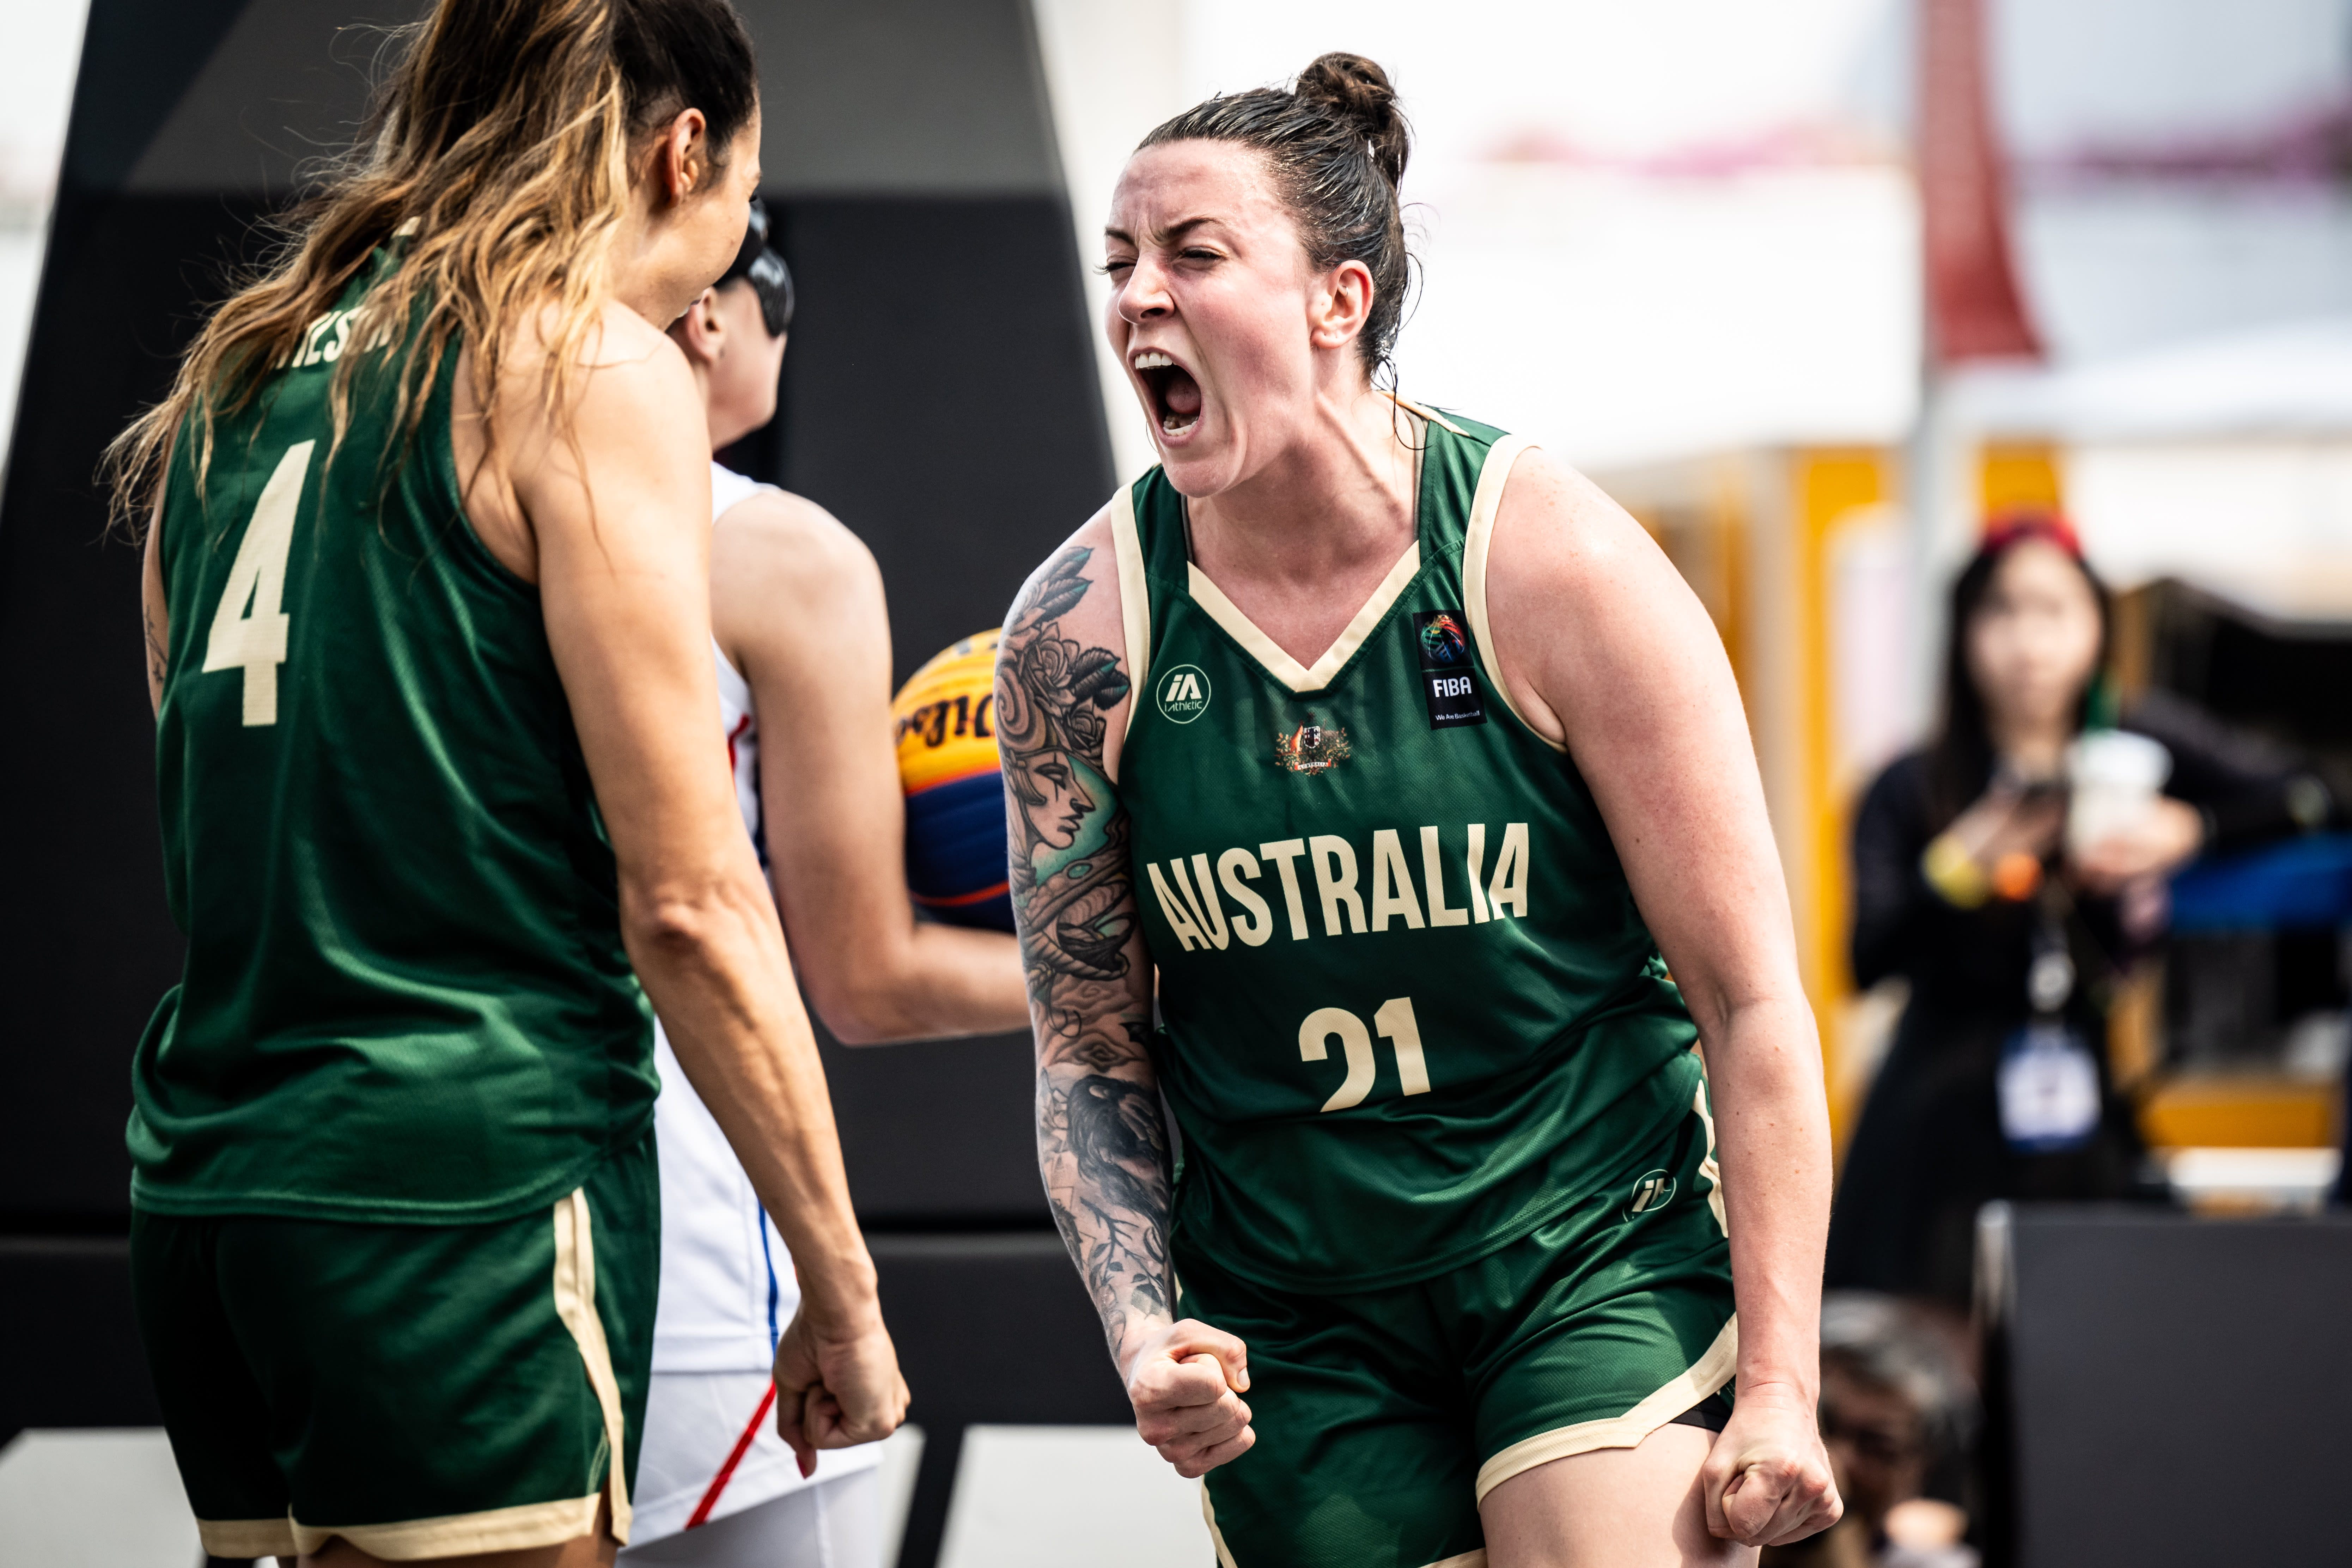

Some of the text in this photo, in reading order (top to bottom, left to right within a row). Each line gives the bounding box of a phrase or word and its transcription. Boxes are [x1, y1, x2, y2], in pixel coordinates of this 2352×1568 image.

[202, 439, 315, 726] 4
[1433, 676, 1472, 697] FIBA
[1455, 710, 1480, 719] Basketball
[1147, 823, 1529, 951] AUSTRALIA
[1298, 997, 1431, 1112] 21
